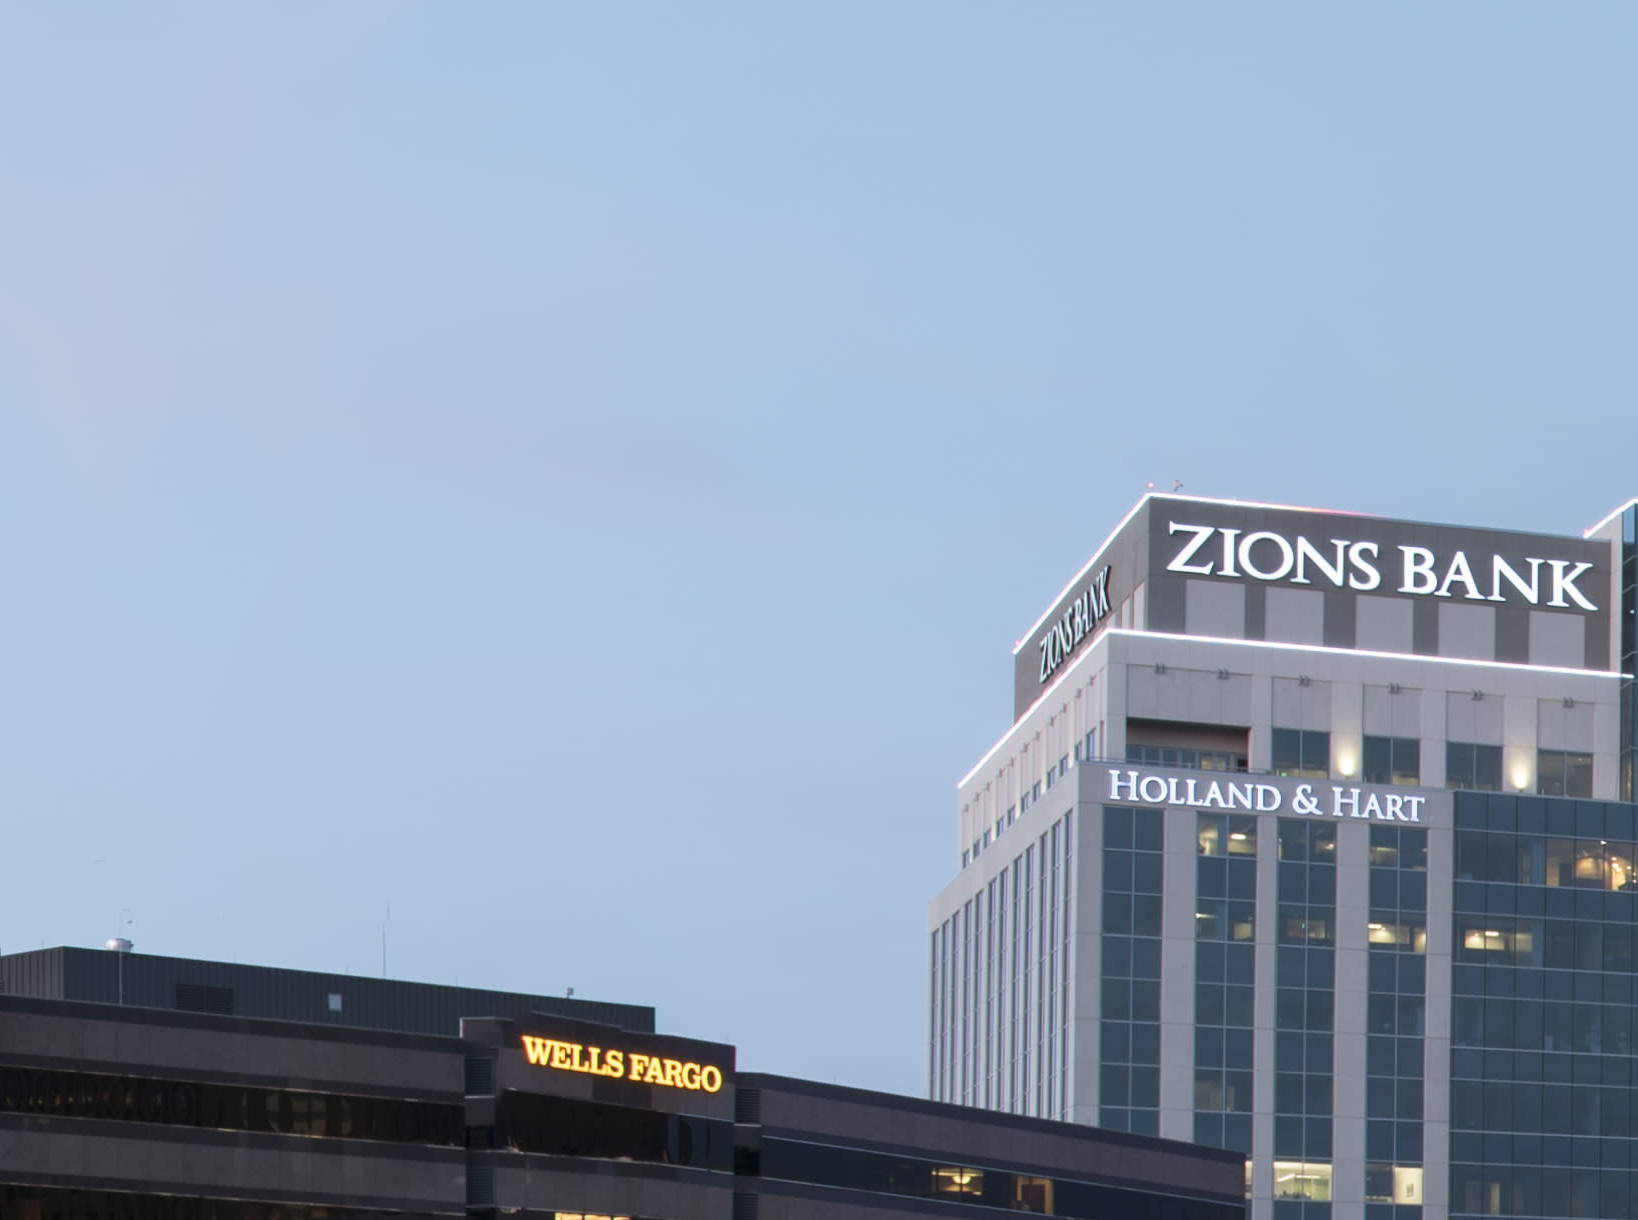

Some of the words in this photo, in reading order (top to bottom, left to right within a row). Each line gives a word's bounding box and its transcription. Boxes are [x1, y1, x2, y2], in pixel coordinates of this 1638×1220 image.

[1166, 520, 1381, 591] ZIONS
[1396, 545, 1598, 612] BANK
[1039, 606, 1074, 684] ZIONS
[1074, 565, 1110, 645] BANK
[1108, 769, 1282, 812] HOLLAND
[1292, 784, 1323, 816] &
[1332, 786, 1425, 822] HART
[522, 1035, 625, 1078] WELLS
[628, 1053, 723, 1093] FARGO
